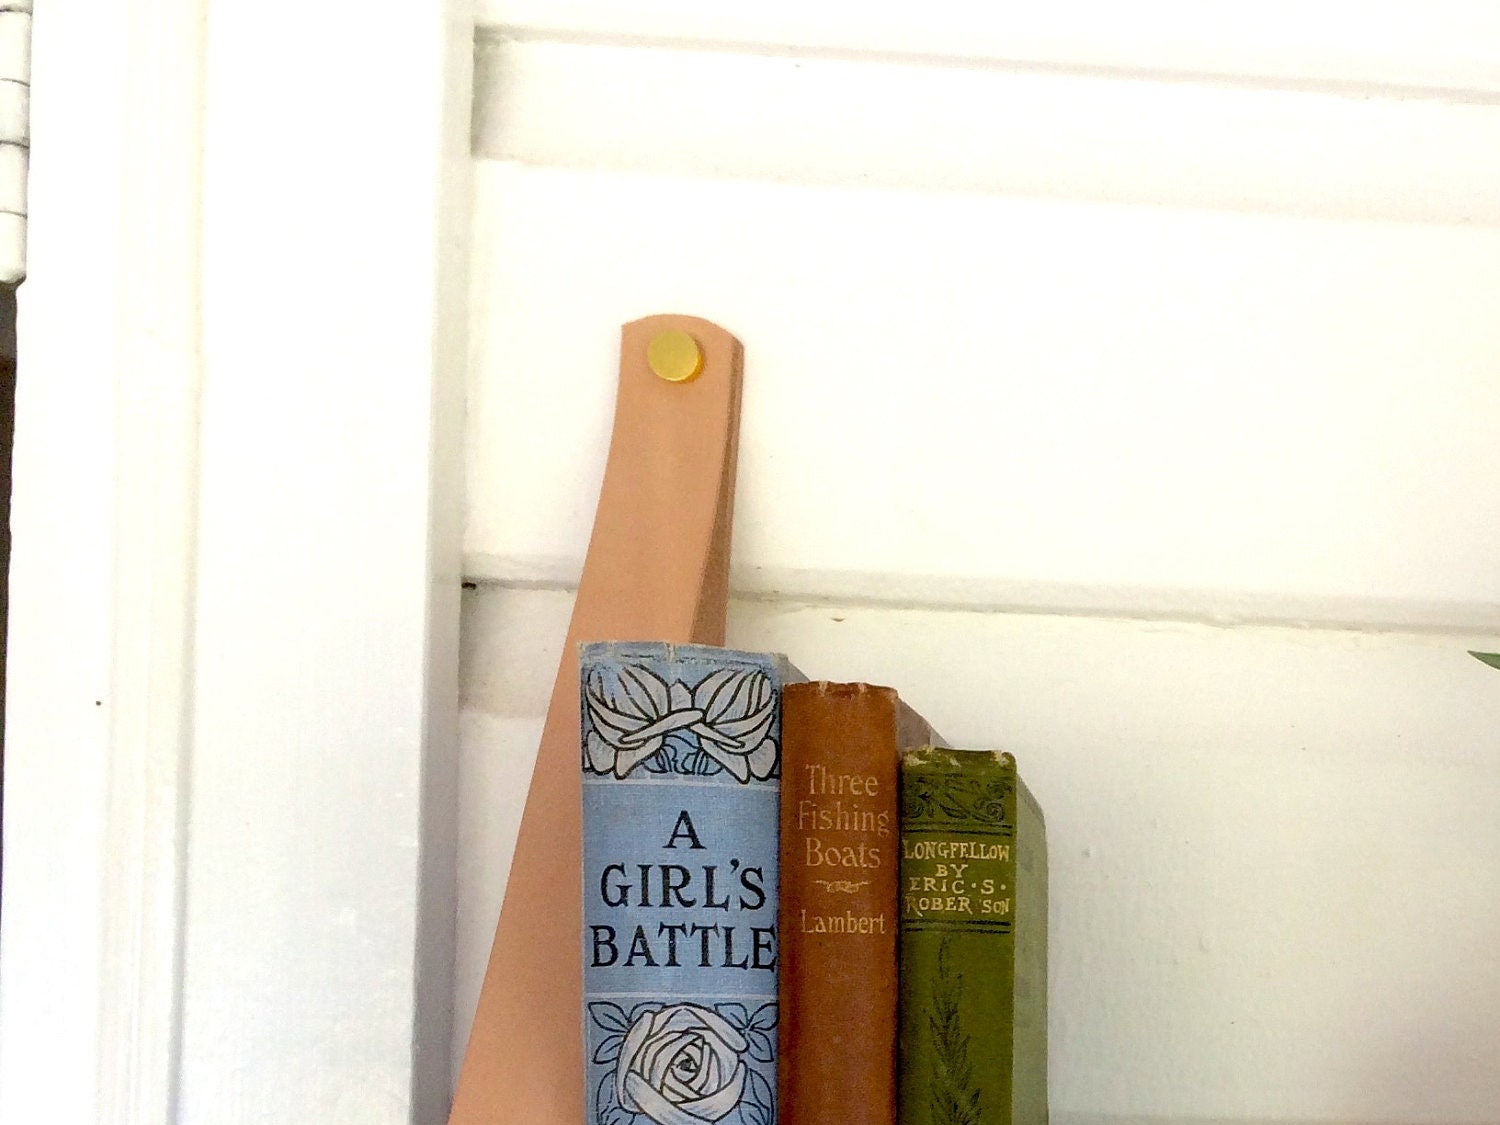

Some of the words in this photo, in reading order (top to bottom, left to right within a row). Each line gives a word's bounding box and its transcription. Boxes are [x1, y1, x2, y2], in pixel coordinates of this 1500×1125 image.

[805, 763, 879, 797] Three
[662, 810, 707, 850] A
[799, 800, 890, 838] Fishing
[806, 837, 881, 869] Boats
[903, 841, 1010, 862] LONGFELLOW
[600, 858, 767, 912] GIRL'S
[935, 863, 969, 879] BY
[801, 909, 886, 934] Lambert
[905, 896, 1010, 917] ROBERSON
[589, 921, 778, 973] BATTLE
